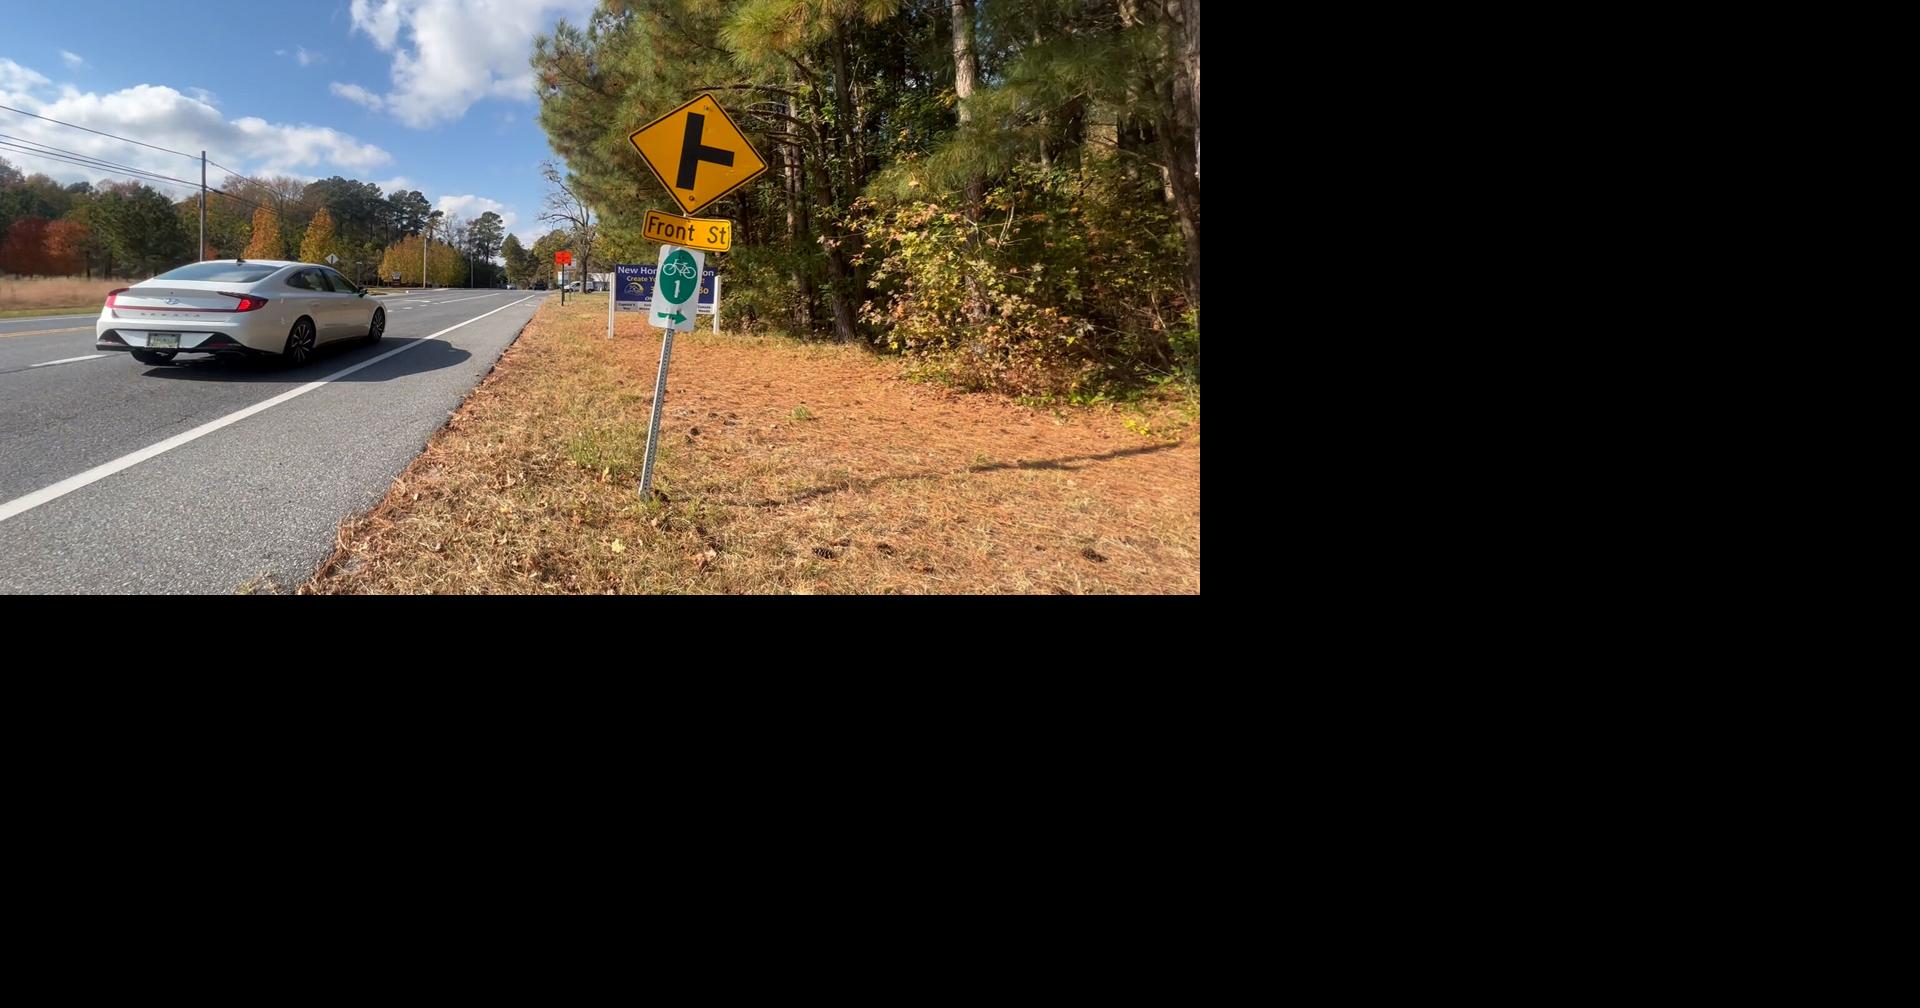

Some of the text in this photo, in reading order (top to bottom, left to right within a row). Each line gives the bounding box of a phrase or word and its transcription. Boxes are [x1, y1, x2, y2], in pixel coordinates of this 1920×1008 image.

[648, 216, 727, 244] Front St
[617, 266, 639, 274] New
[674, 280, 680, 298] 1
